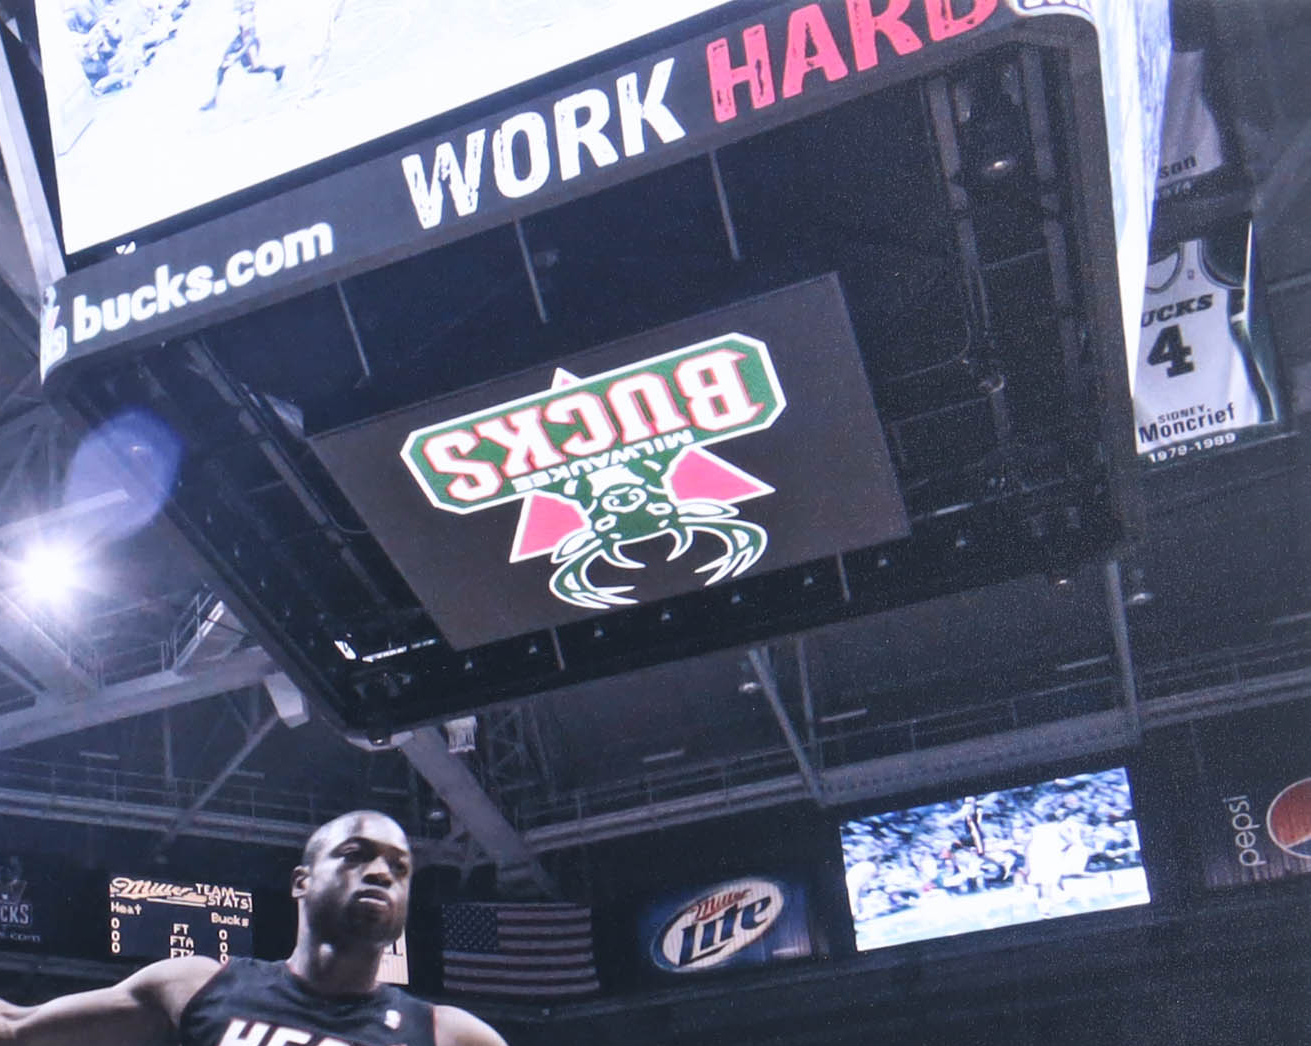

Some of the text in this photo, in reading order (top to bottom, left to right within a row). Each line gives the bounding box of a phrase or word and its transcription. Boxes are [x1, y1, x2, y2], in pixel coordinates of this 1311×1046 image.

[401, 0, 998, 230] WORK HARD
[72, 222, 334, 344] bucks.com
[1140, 294, 1214, 328] UCKS
[1147, 324, 1195, 378] 4
[422, 347, 766, 502] BUCKS
[1139, 402, 1235, 444] Moncrief
[1157, 405, 1207, 425] SIDNEY
[510, 429, 696, 493] MILWAUKEE
[1222, 795, 1267, 867] pepsi
[110, 901, 142, 915] Heat
[195, 883, 236, 898] TEAM
[207, 895, 250, 910] STATS
[173, 923, 189, 935] FT
[210, 911, 250, 928] Bucks
[679, 896, 772, 967] Lite
[169, 935, 195, 949] FTA
